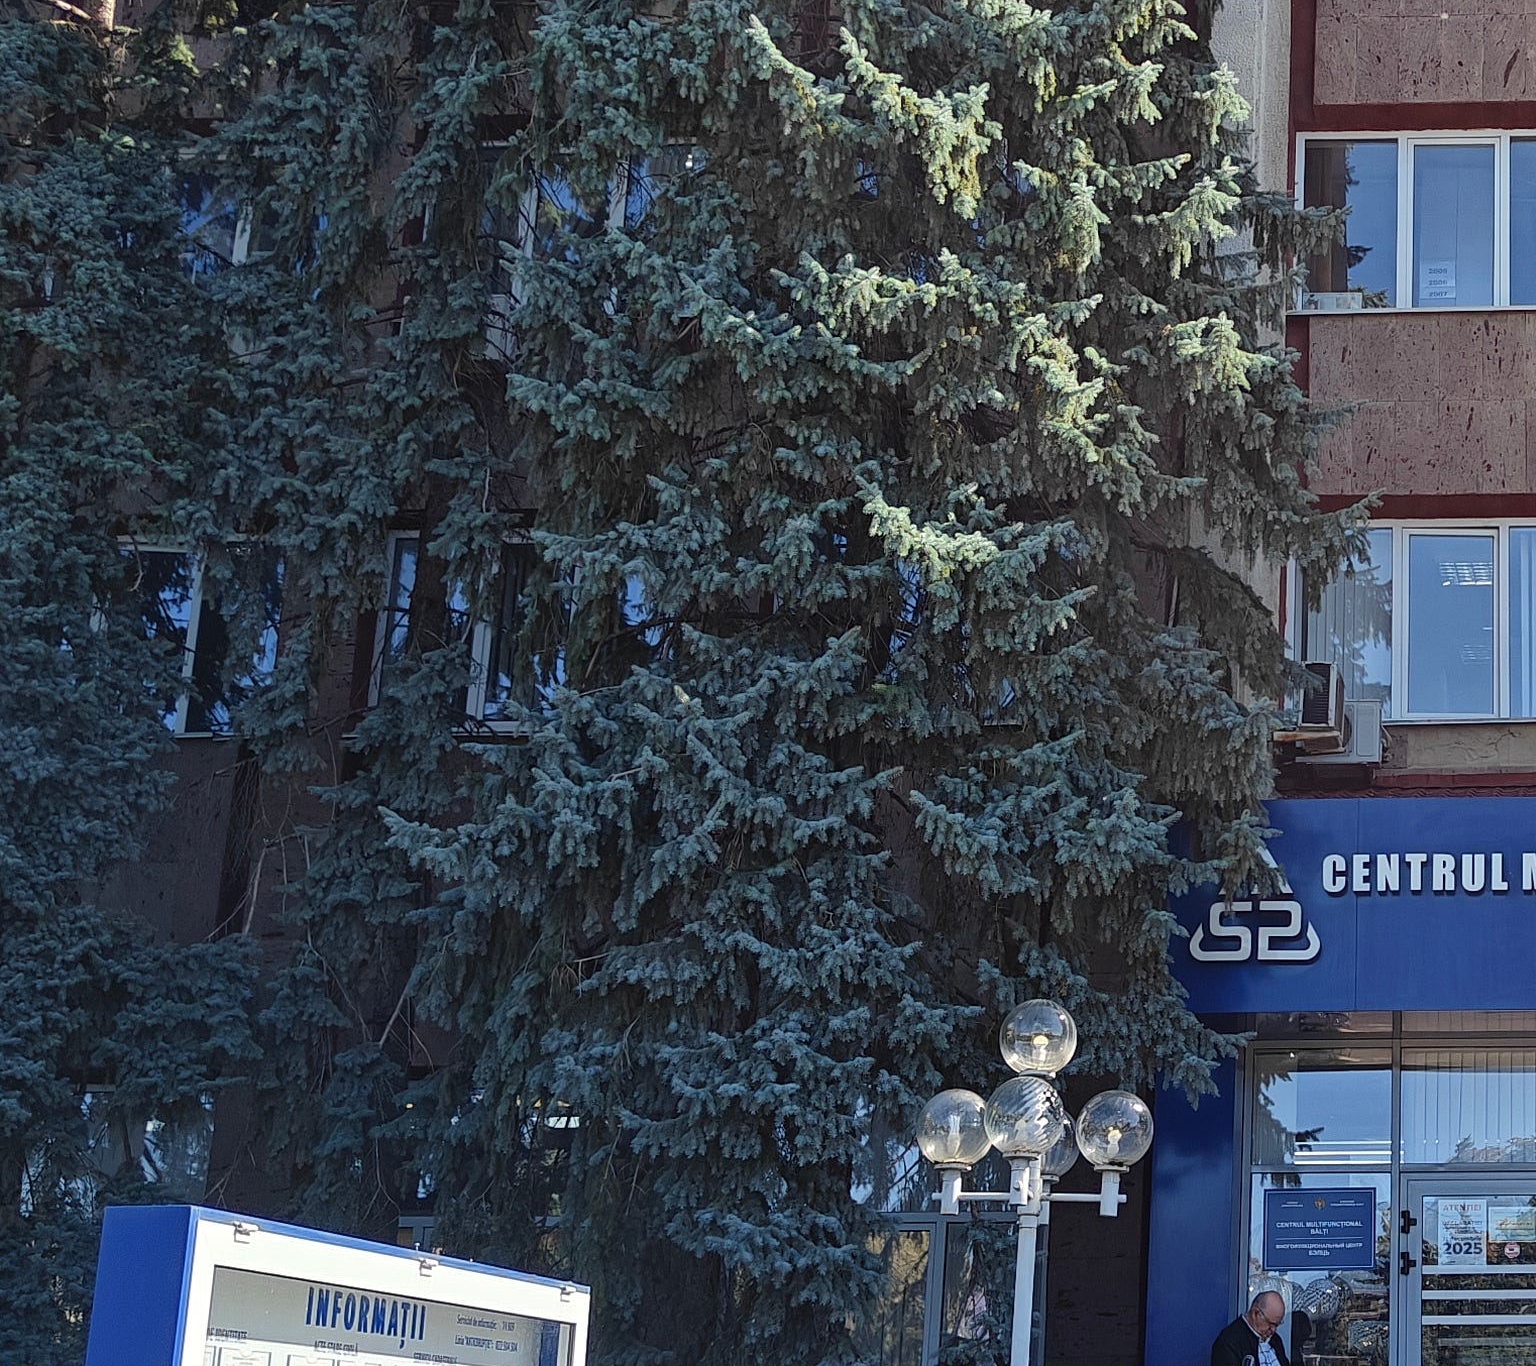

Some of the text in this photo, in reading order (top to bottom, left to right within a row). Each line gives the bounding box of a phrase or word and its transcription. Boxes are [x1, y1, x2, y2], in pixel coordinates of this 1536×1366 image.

[1321, 852, 1509, 893] CENTRUL
[1442, 1241, 1483, 1255] 2025
[304, 1286, 427, 1349] INFORMAȚII
